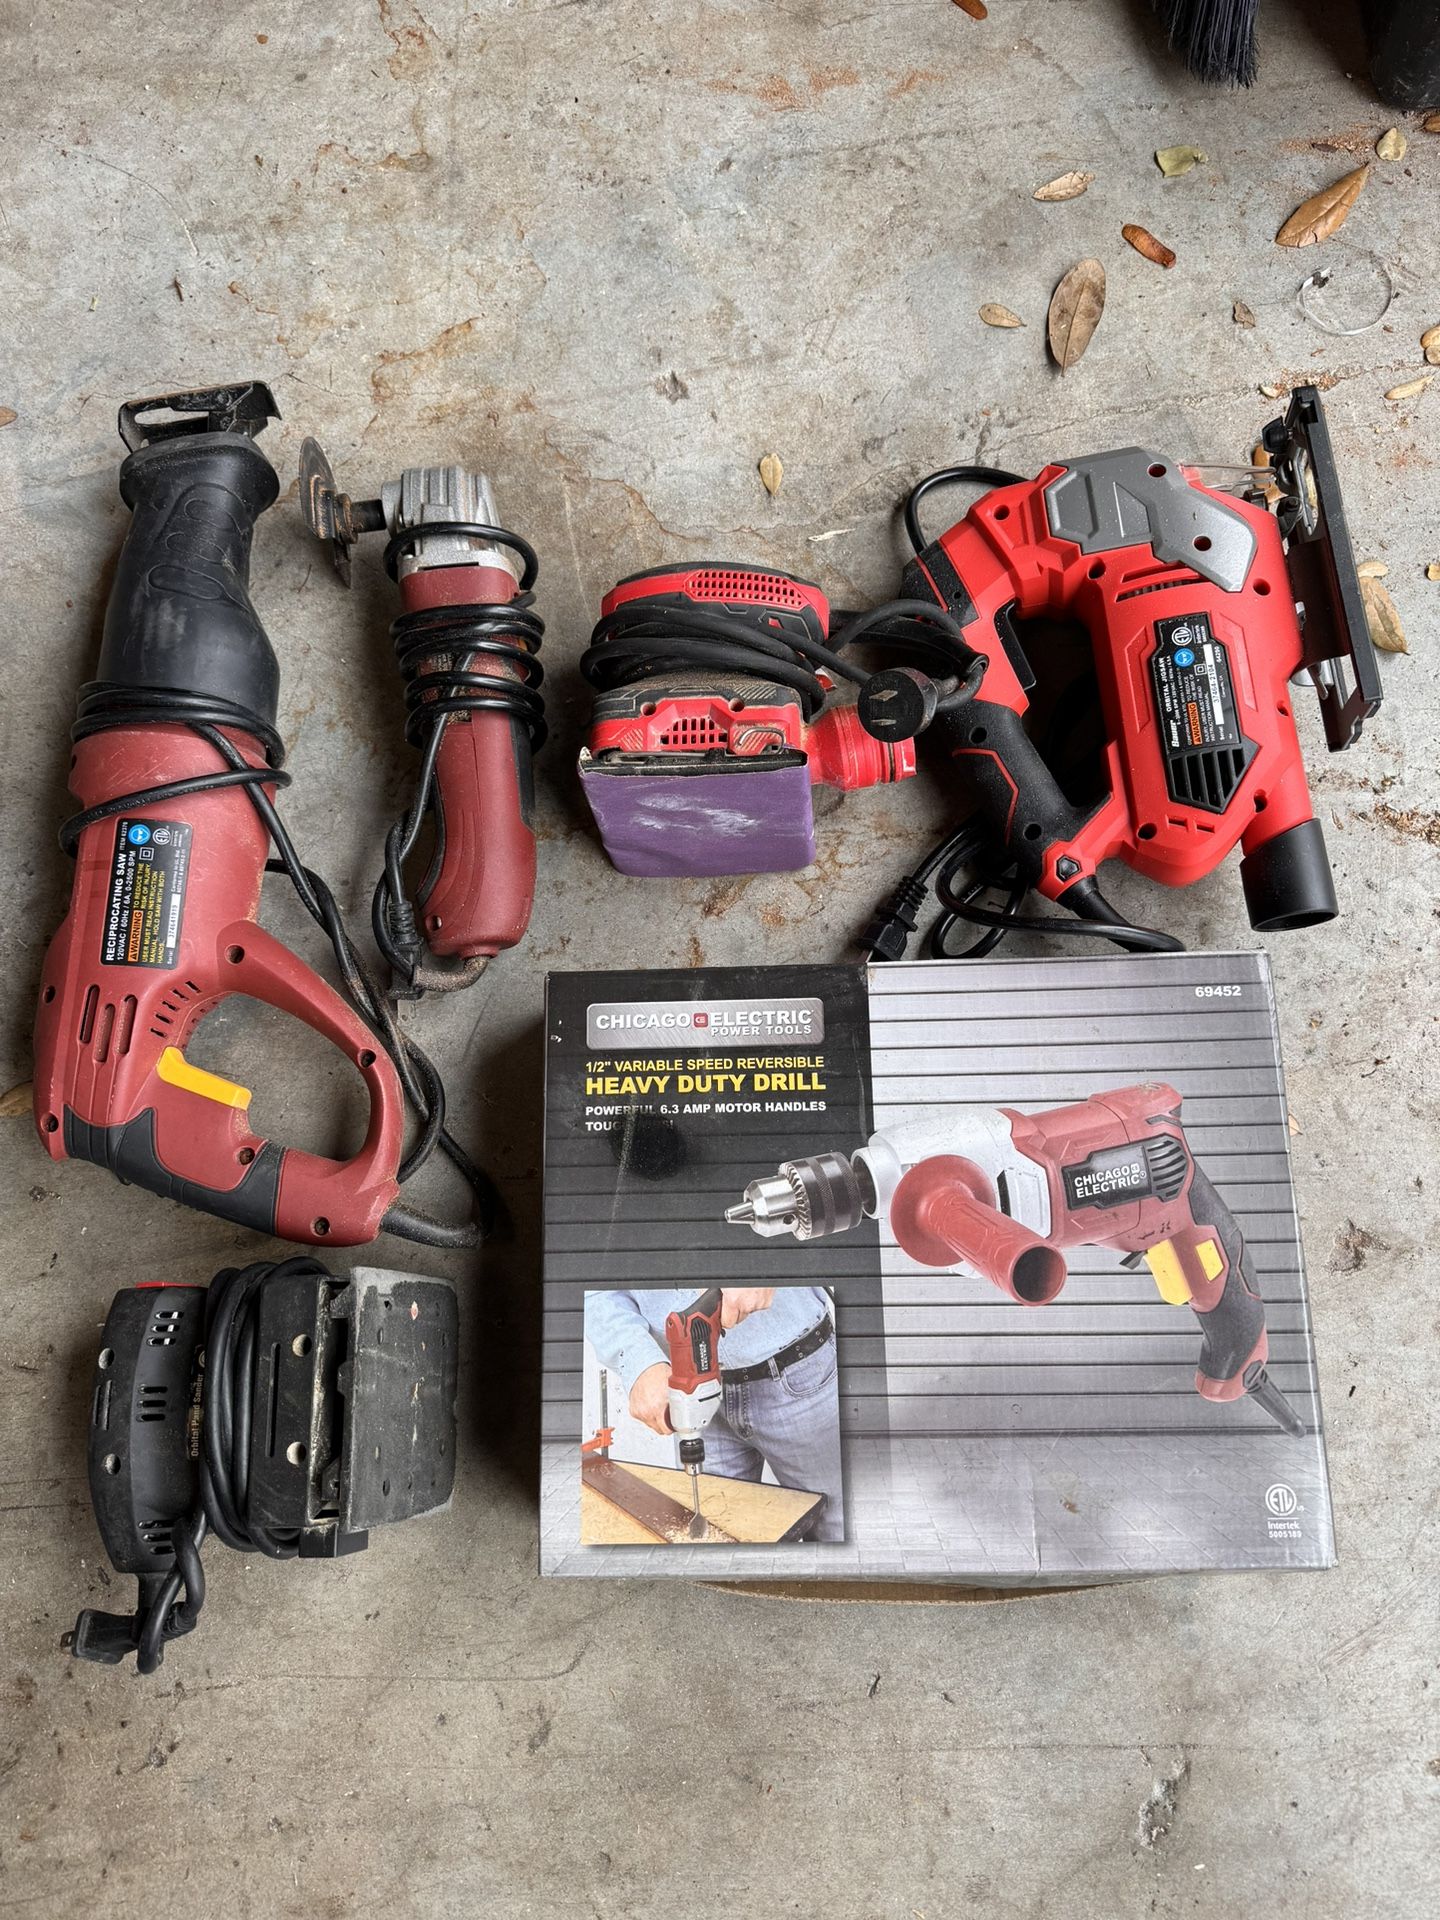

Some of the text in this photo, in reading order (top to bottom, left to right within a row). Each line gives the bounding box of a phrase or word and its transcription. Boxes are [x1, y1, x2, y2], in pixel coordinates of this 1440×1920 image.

[1158, 657, 1172, 712] ORBITAL JIGSAW
[1190, 704, 1200, 737] WARNING
[1170, 720, 1180, 747] Bauer
[128, 850, 136, 866] SPM
[125, 868, 134, 892] 0-2500
[134, 875, 142, 900] REDUCE
[158, 870, 166, 888] BOTH
[142, 886, 148, 894] OF
[148, 870, 158, 910] INSTRUCTION
[156, 888, 164, 903] WITH
[106, 878, 124, 960] RECIPROCATING
[116, 853, 126, 875] SAW
[133, 900, 140, 908] TO
[140, 895, 148, 909] RISK
[154, 904, 162, 918] SAW
[121, 910, 130, 928] 60Hz
[152, 918, 160, 936] HOLD
[130, 911, 142, 953] WARNING
[143, 928, 151, 944] MUST
[117, 933, 126, 960] 120VAC
[142, 946, 150, 962] USER
[1195, 985, 1242, 997] 69452
[596, 1012, 691, 1030] CHICAGO
[710, 1009, 814, 1027] ELECTRIC
[711, 1025, 812, 1037] POWER TOOLS
[586, 1055, 825, 1073] 1/2" VARIABLE SPEED REVERSIBLE
[586, 1071, 827, 1096] HEAVY DUTY DRILL
[660, 1103, 680, 1115] 6.3
[682, 1103, 711, 1114] AMP
[715, 1102, 762, 1113] MOTOR
[765, 1100, 827, 1112] HANDLES
[1074, 1165, 1130, 1188] CHICAGO
[1075, 1173, 1141, 1199] ELECTRIC
[192, 1374, 204, 1403] Sander
[190, 1428, 200, 1457] Orbital
[1267, 1521, 1300, 1530] Intertek
